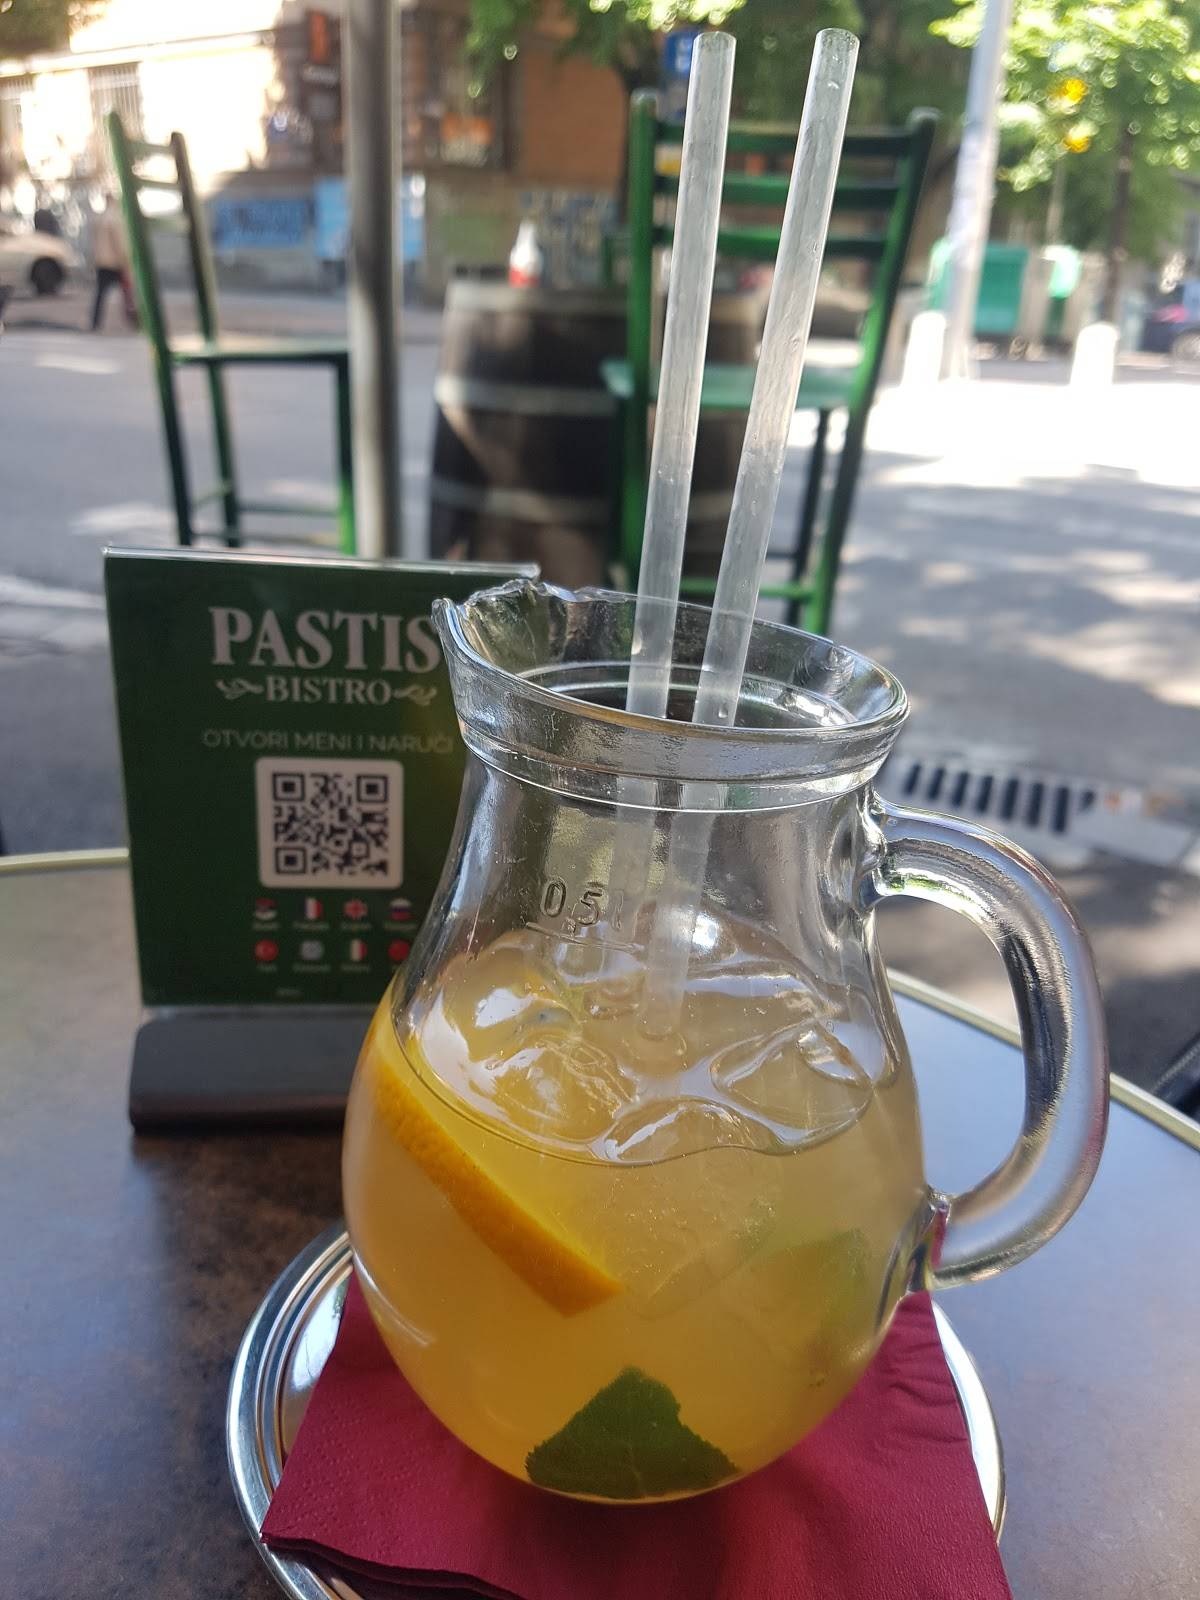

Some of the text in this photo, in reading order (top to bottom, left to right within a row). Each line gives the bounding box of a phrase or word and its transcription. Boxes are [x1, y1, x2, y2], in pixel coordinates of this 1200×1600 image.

[208, 606, 441, 673] PASTIS
[266, 675, 393, 704] BISTRO
[203, 728, 288, 748] OTVORI
[294, 731, 352, 751] MENI
